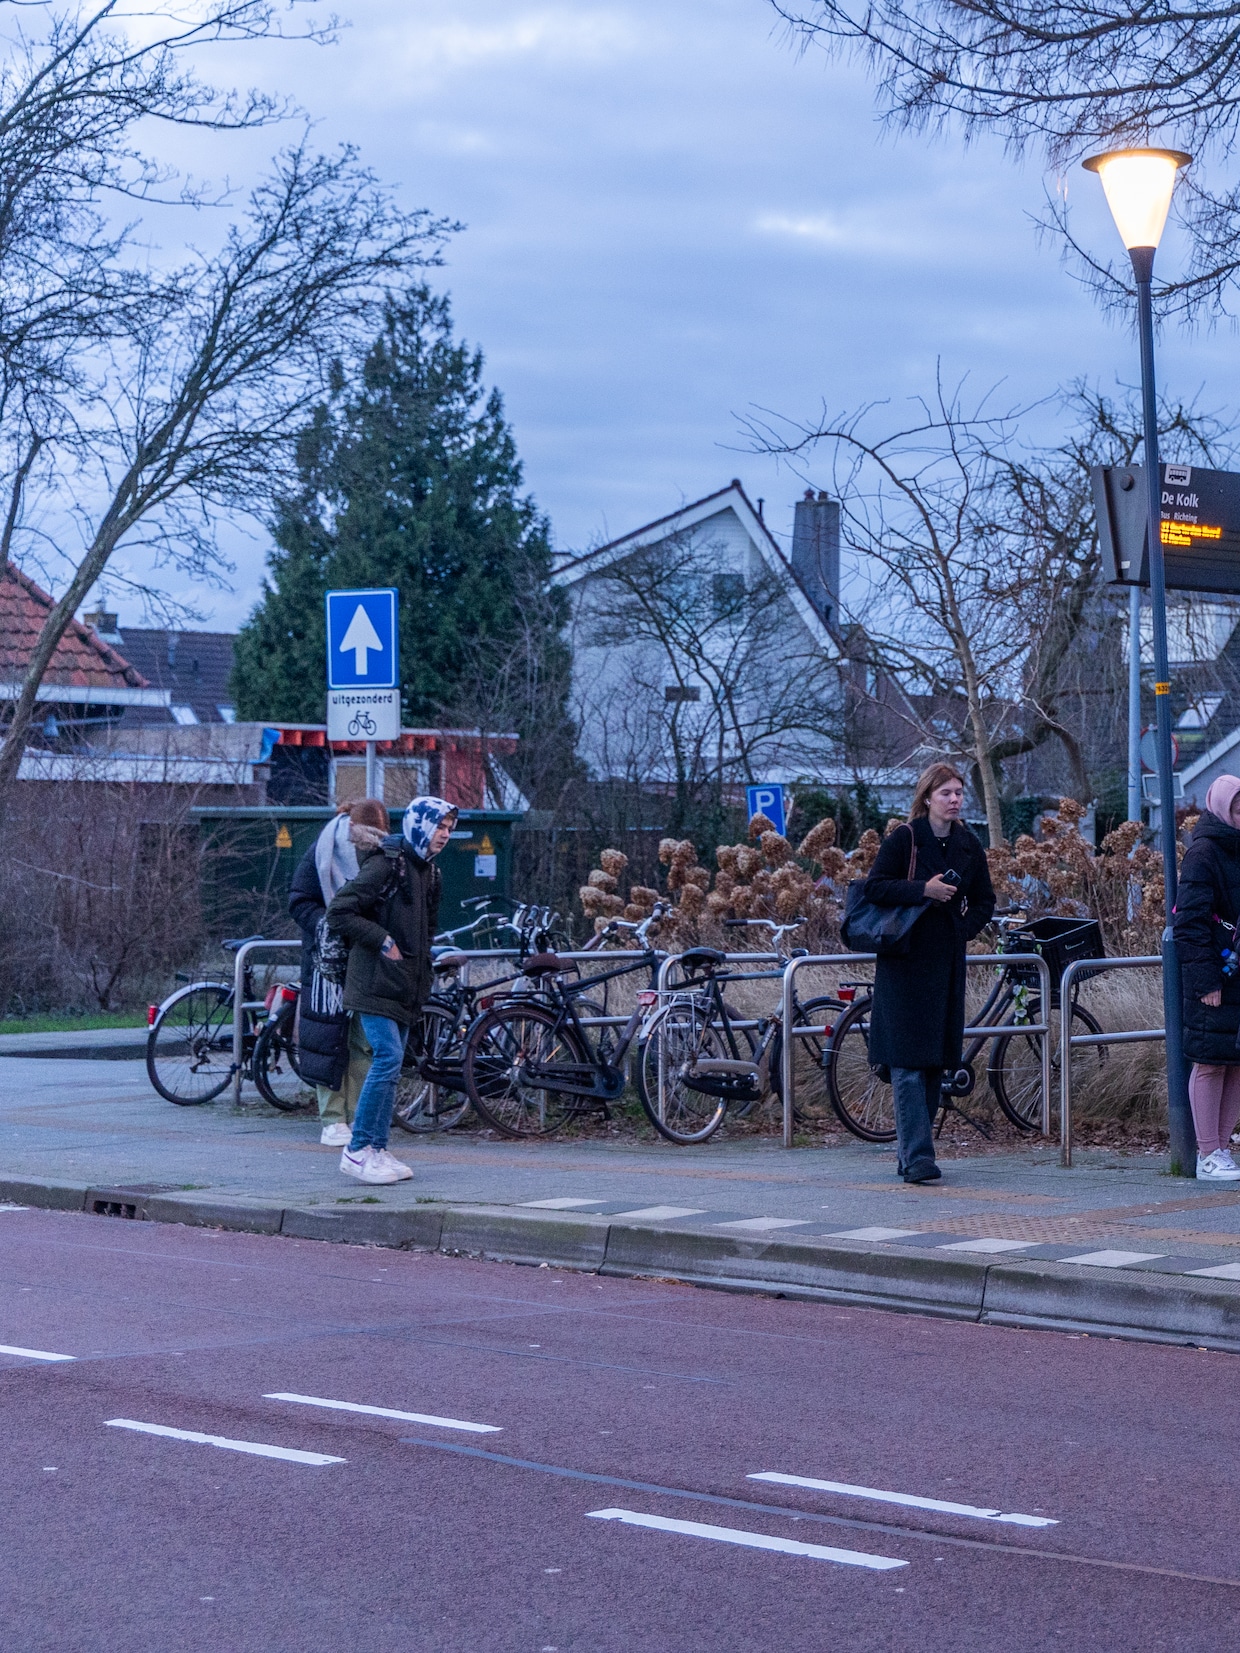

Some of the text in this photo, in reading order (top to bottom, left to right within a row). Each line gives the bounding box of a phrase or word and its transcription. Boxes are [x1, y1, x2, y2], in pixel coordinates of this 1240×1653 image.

[1161, 491, 1199, 508] De Kolk
[1173, 512, 1198, 525] Richting
[332, 693, 393, 707] uitgezonderd
[755, 790, 775, 814] P
